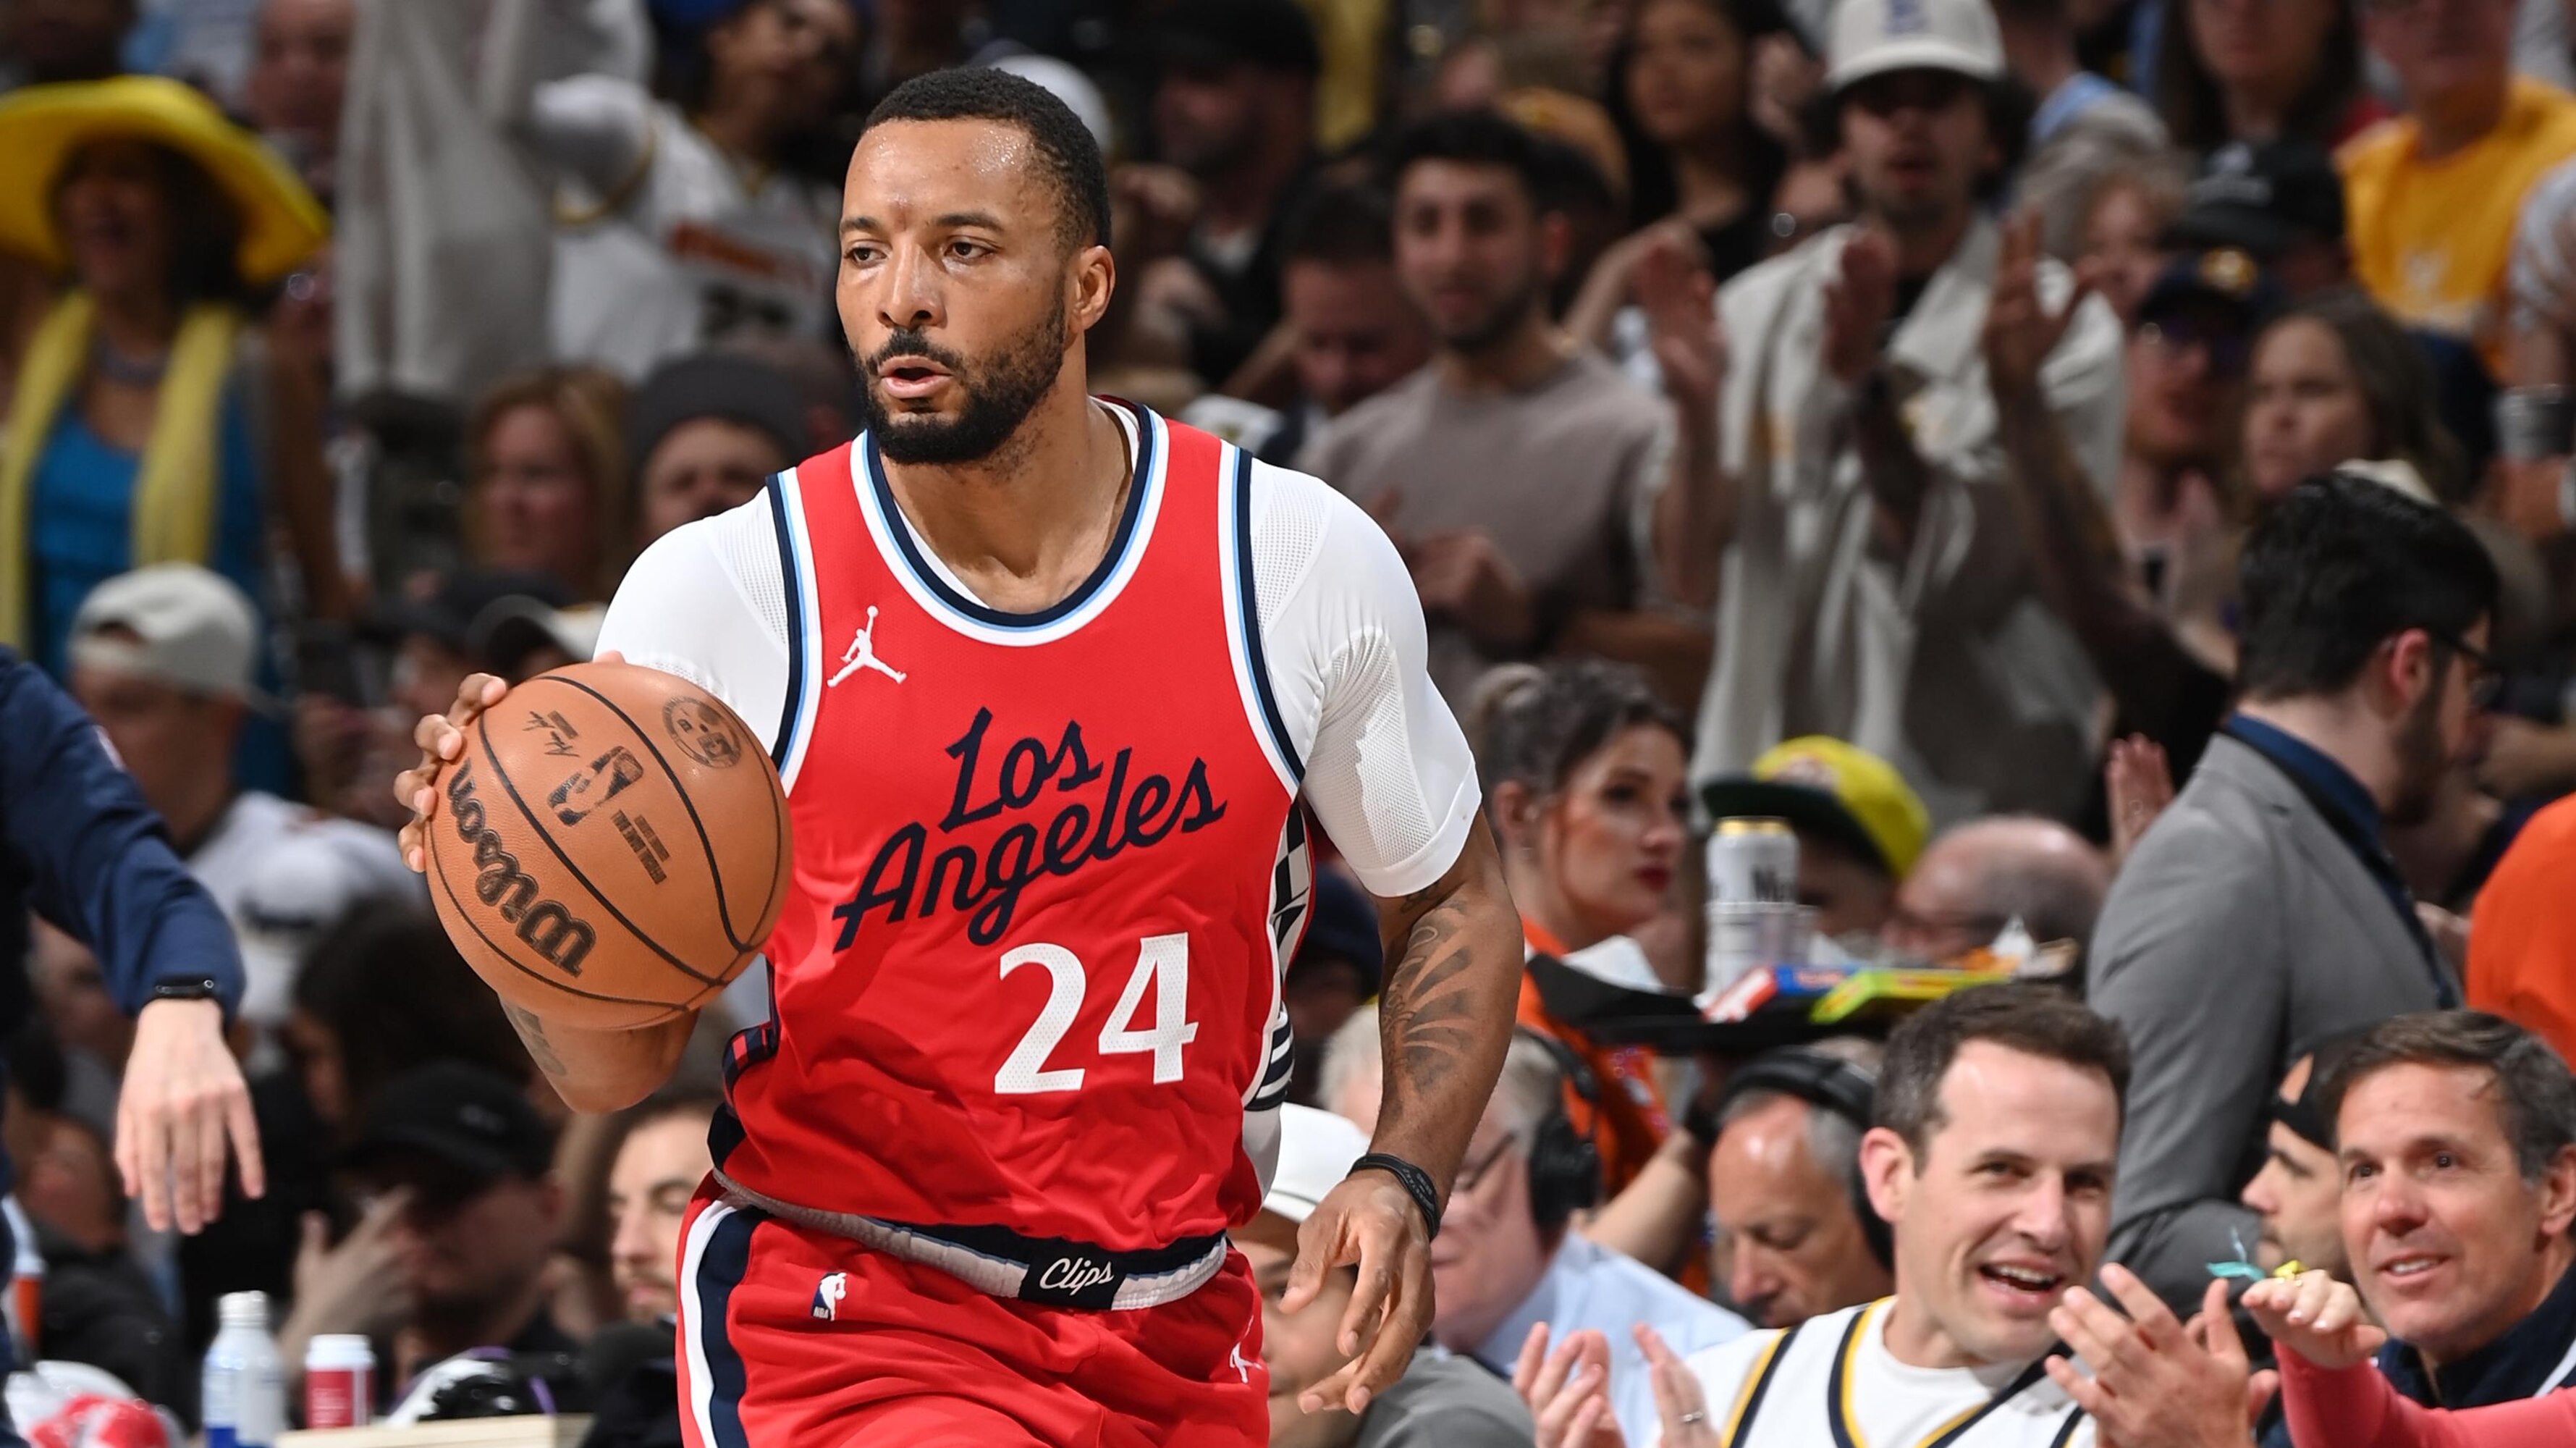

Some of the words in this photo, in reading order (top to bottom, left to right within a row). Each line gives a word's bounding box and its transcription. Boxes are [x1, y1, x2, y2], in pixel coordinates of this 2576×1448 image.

[832, 746, 1228, 954] Angeles
[939, 706, 1104, 833] Los
[447, 757, 596, 977] Wilson
[994, 931, 1199, 1095] 24
[1039, 1257, 1115, 1296] Clips
